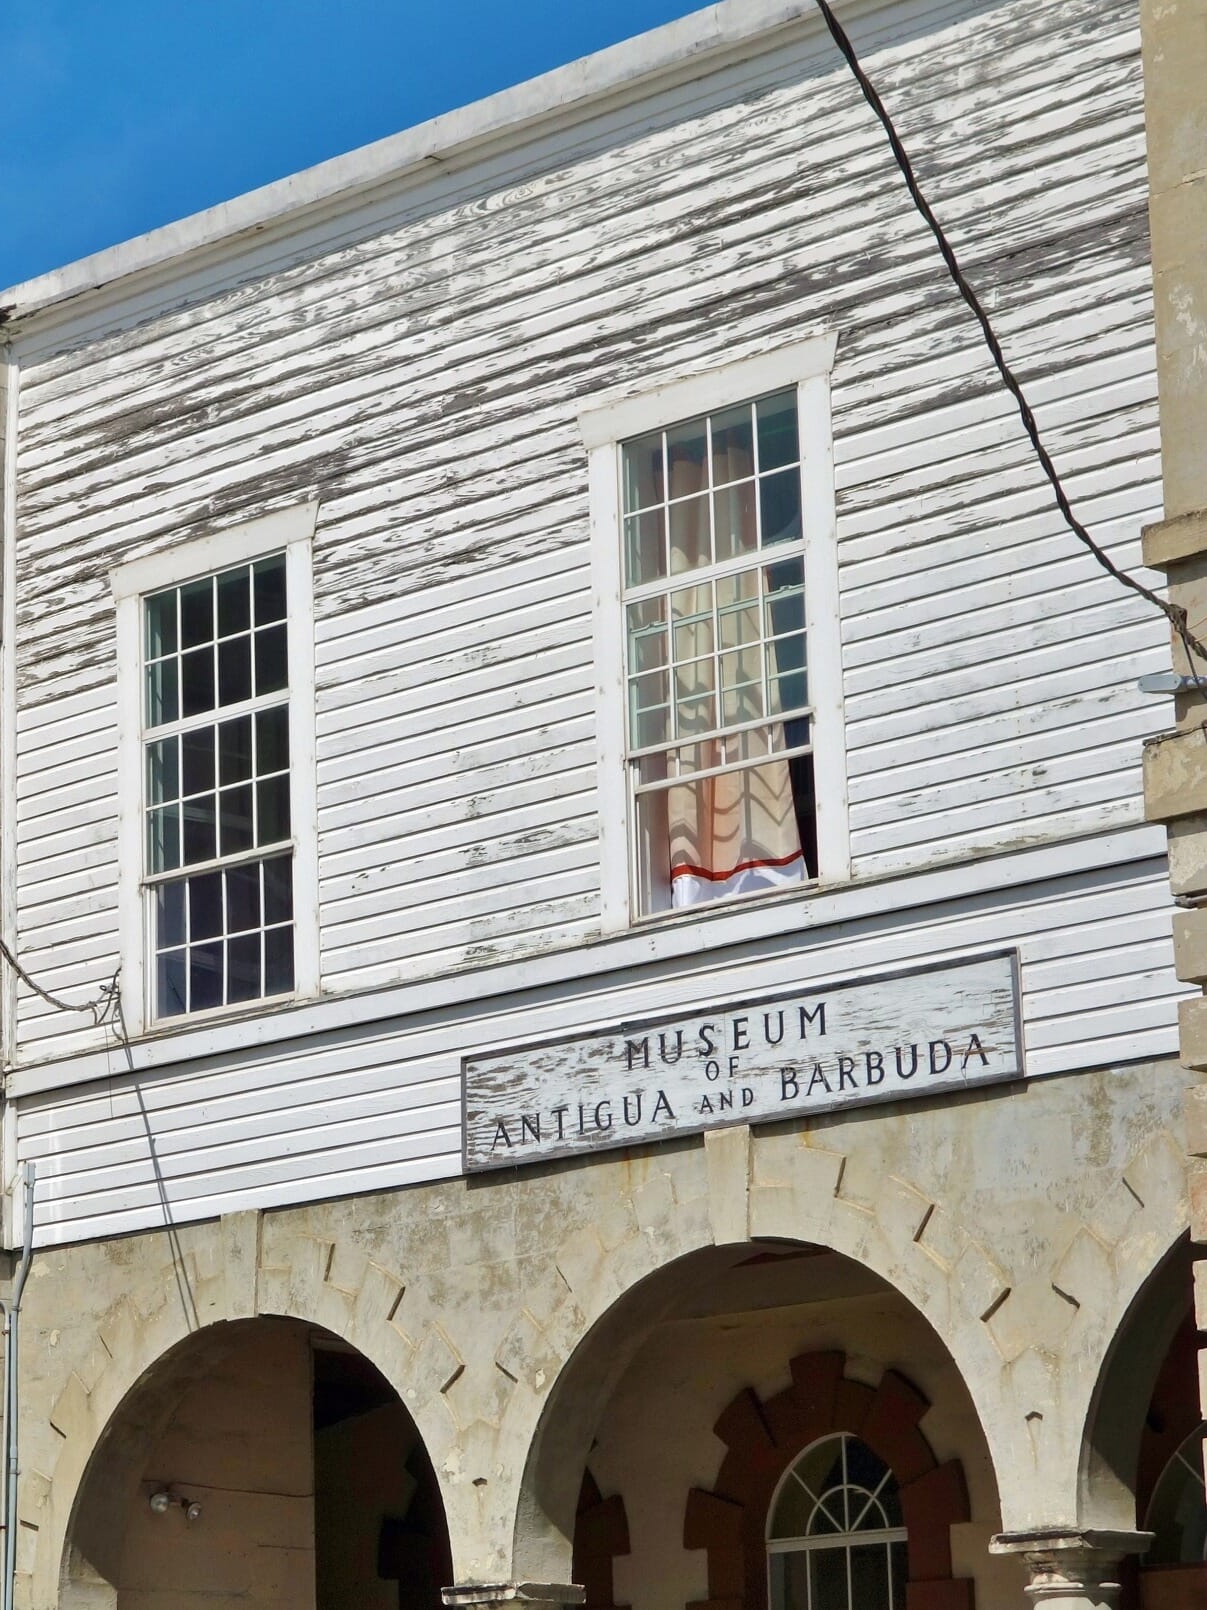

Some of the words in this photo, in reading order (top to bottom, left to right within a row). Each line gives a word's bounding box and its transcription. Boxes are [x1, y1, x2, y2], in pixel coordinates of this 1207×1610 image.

[625, 1002, 827, 1070] MUSEUM
[705, 1055, 739, 1081] OF
[491, 1090, 676, 1151] ANTIGUA
[699, 1087, 754, 1114] AND
[779, 1033, 990, 1101] BARBUDA
